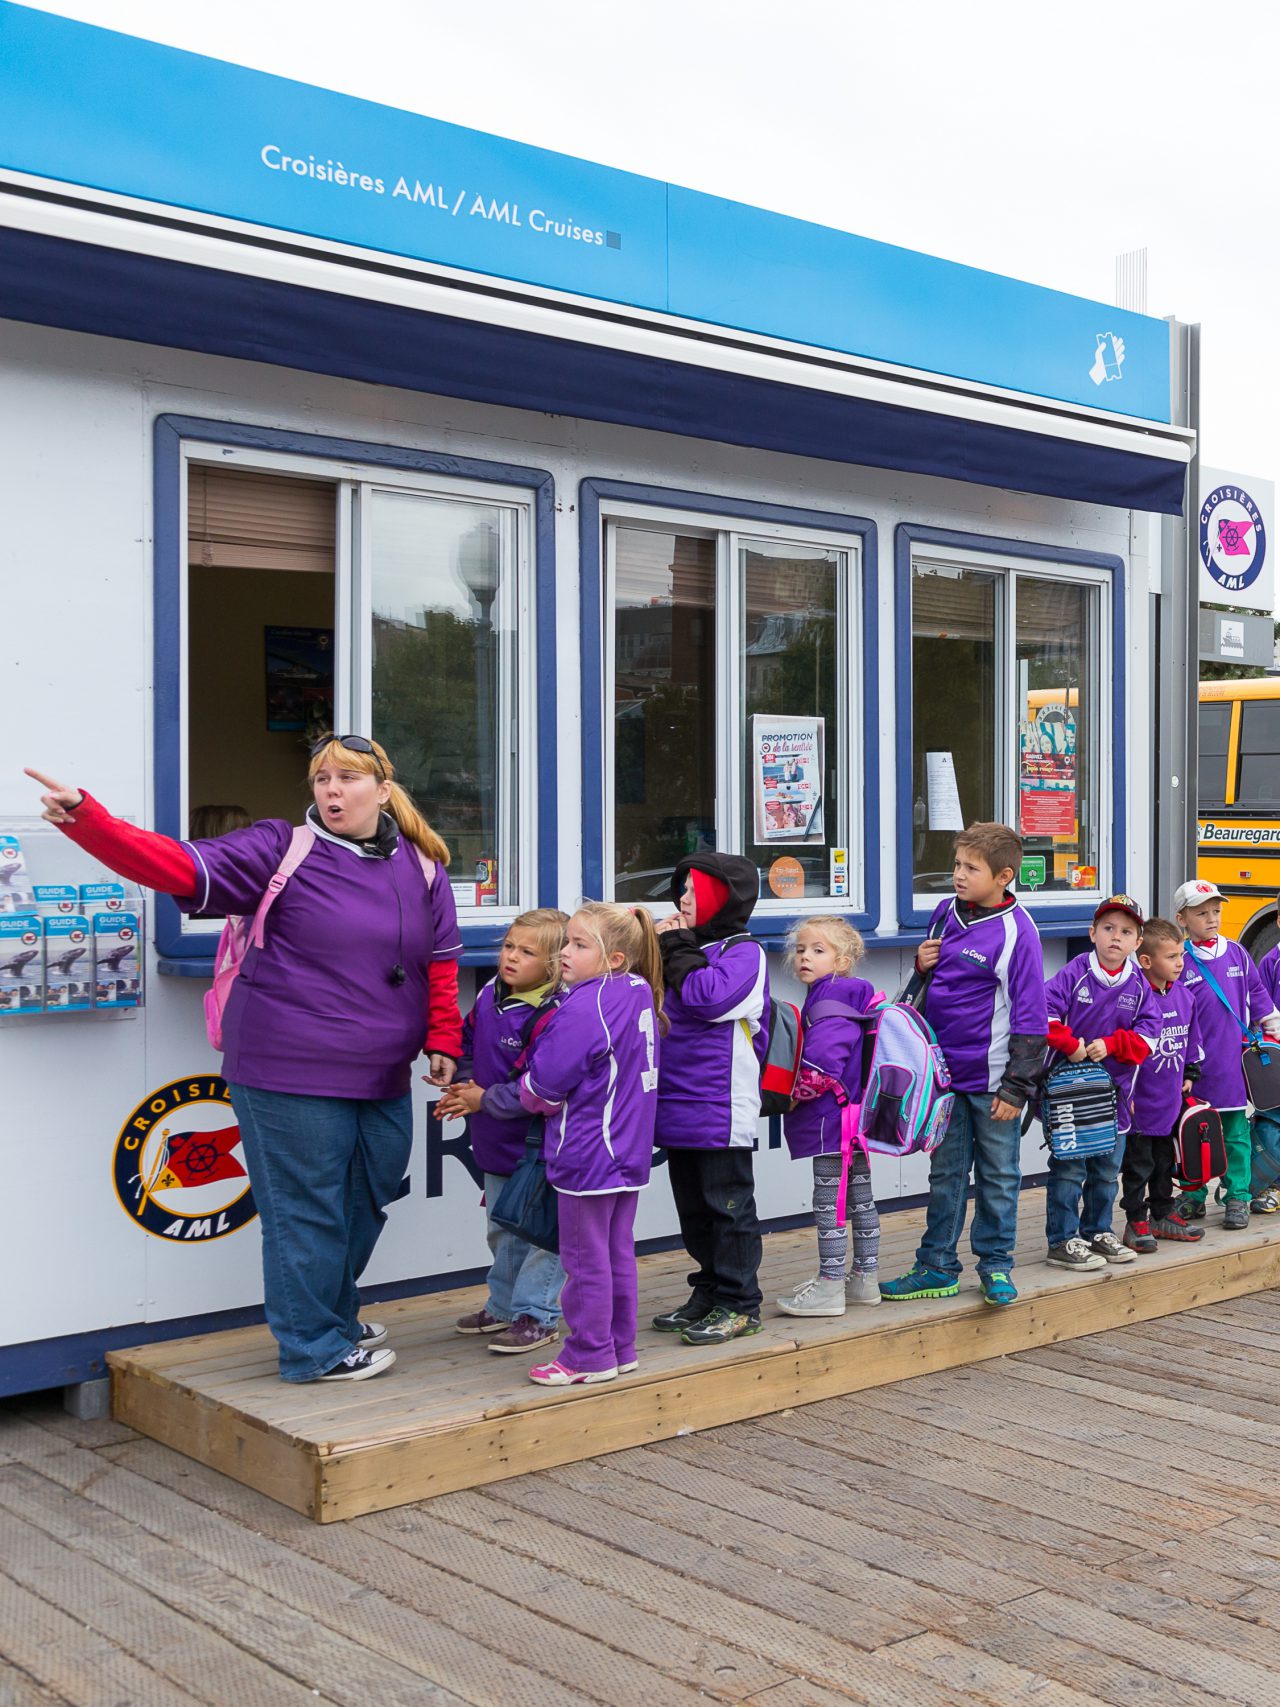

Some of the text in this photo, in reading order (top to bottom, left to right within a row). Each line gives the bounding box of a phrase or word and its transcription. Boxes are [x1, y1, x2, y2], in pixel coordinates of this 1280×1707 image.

[260, 145, 603, 246] Croisières AML / AML Cruises
[1200, 488, 1262, 533] CROISIÈRES
[1217, 573, 1245, 589] AML
[762, 733, 813, 742] PROMOTION
[37, 887, 66, 895] GUIDE
[85, 886, 113, 894] GUIDE
[0, 920, 29, 928] GUIDE
[48, 918, 77, 926] GUIDE
[969, 949, 987, 963] Coop
[638, 1007, 658, 1093] 1
[1056, 1103, 1078, 1151] ROOTS
[163, 1212, 231, 1239] AML
